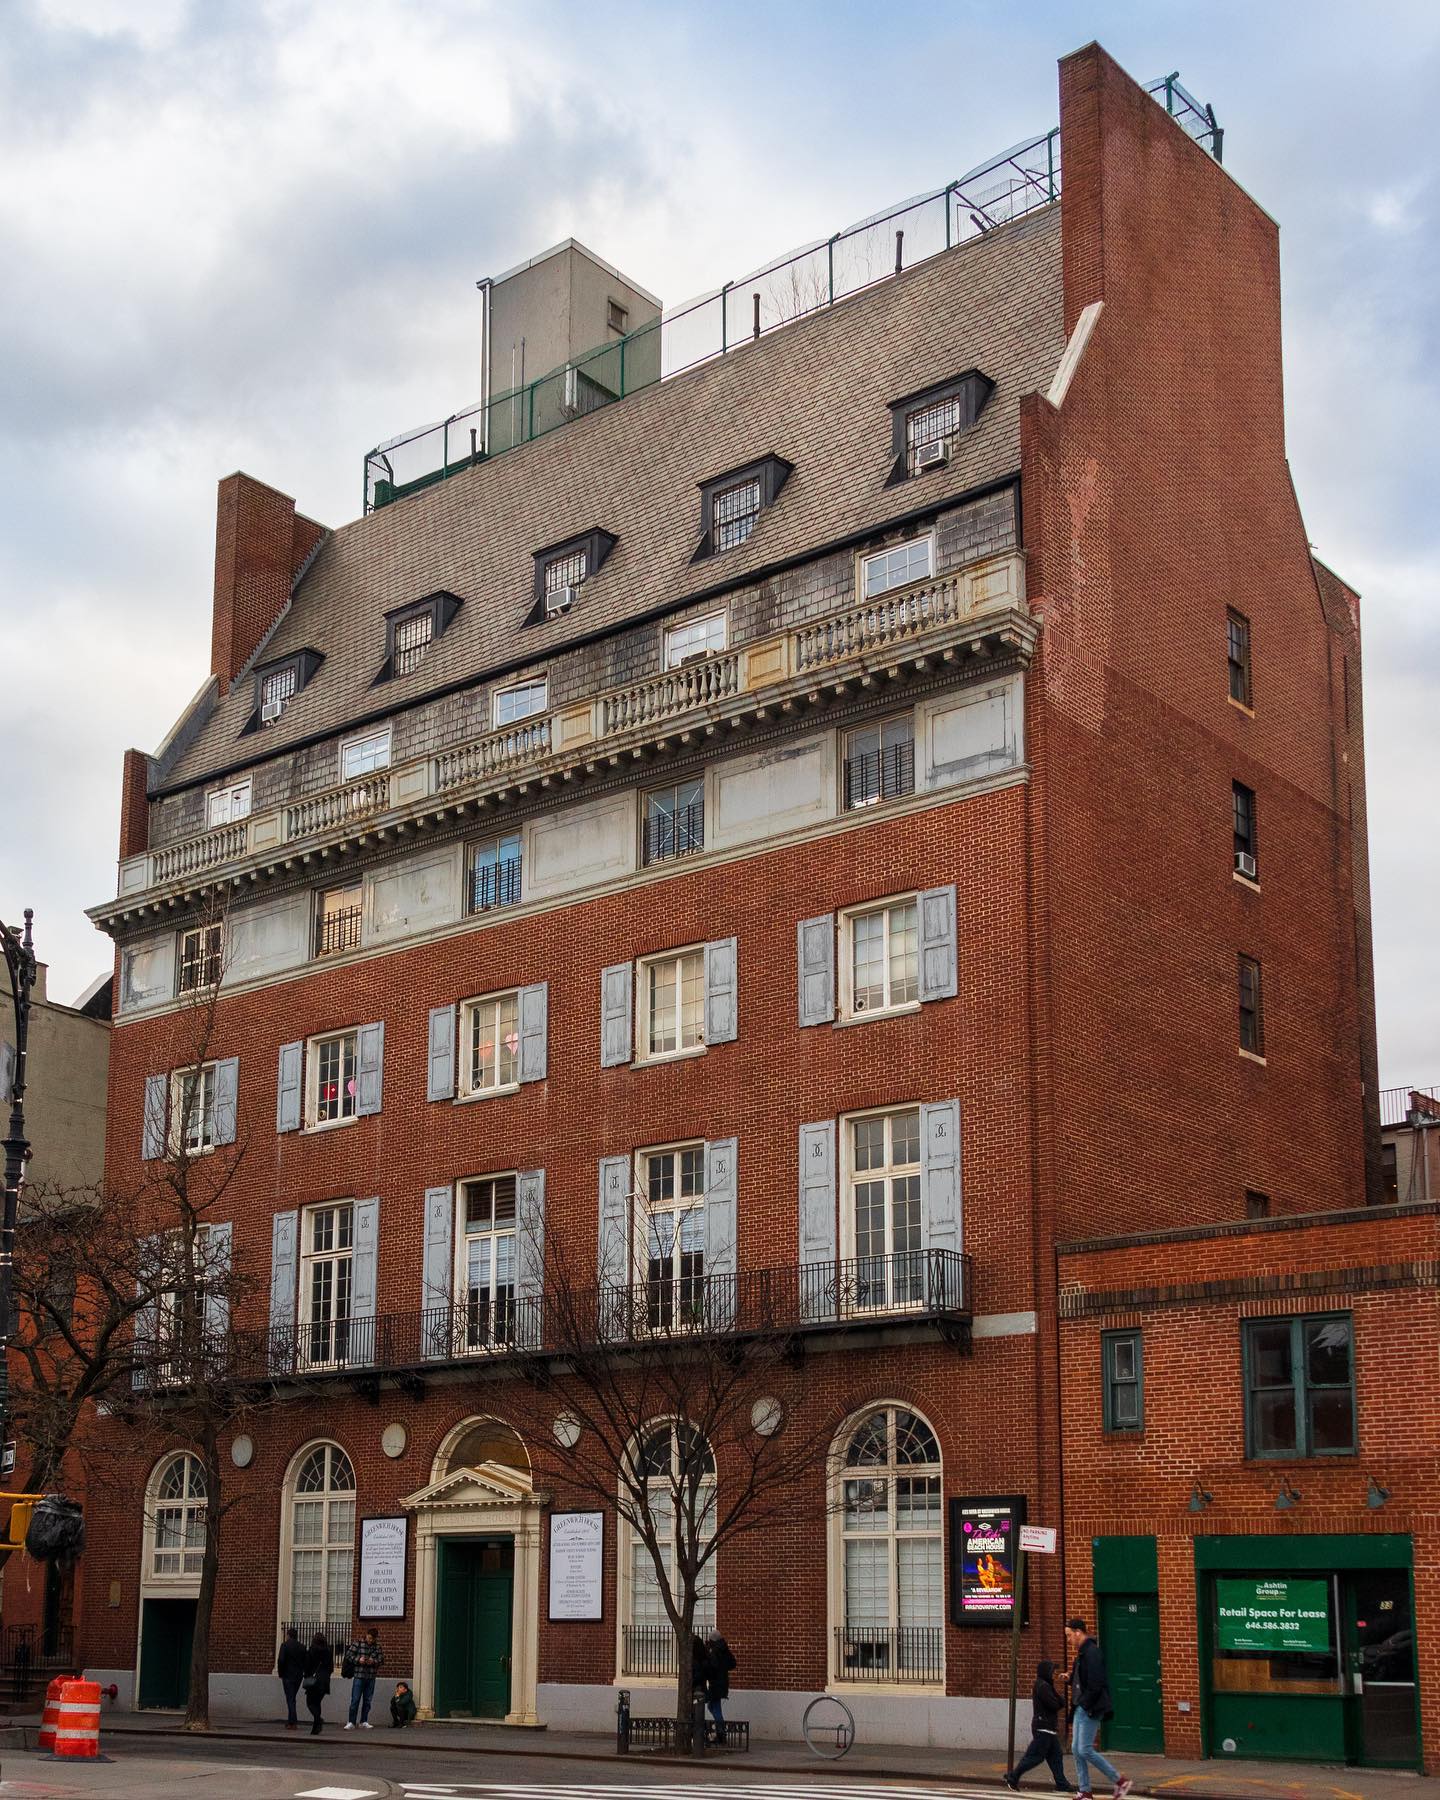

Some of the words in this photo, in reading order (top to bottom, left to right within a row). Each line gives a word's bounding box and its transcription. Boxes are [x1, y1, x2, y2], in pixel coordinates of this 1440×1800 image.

[967, 1537, 1005, 1545] AMERICAN
[1256, 1588, 1279, 1596] Group
[1219, 1607, 1247, 1617] Retail
[1248, 1608, 1278, 1620] Space
[1279, 1608, 1295, 1618] For
[1297, 1609, 1327, 1619] Lease
[1245, 1622, 1300, 1630] 646.586.3832
